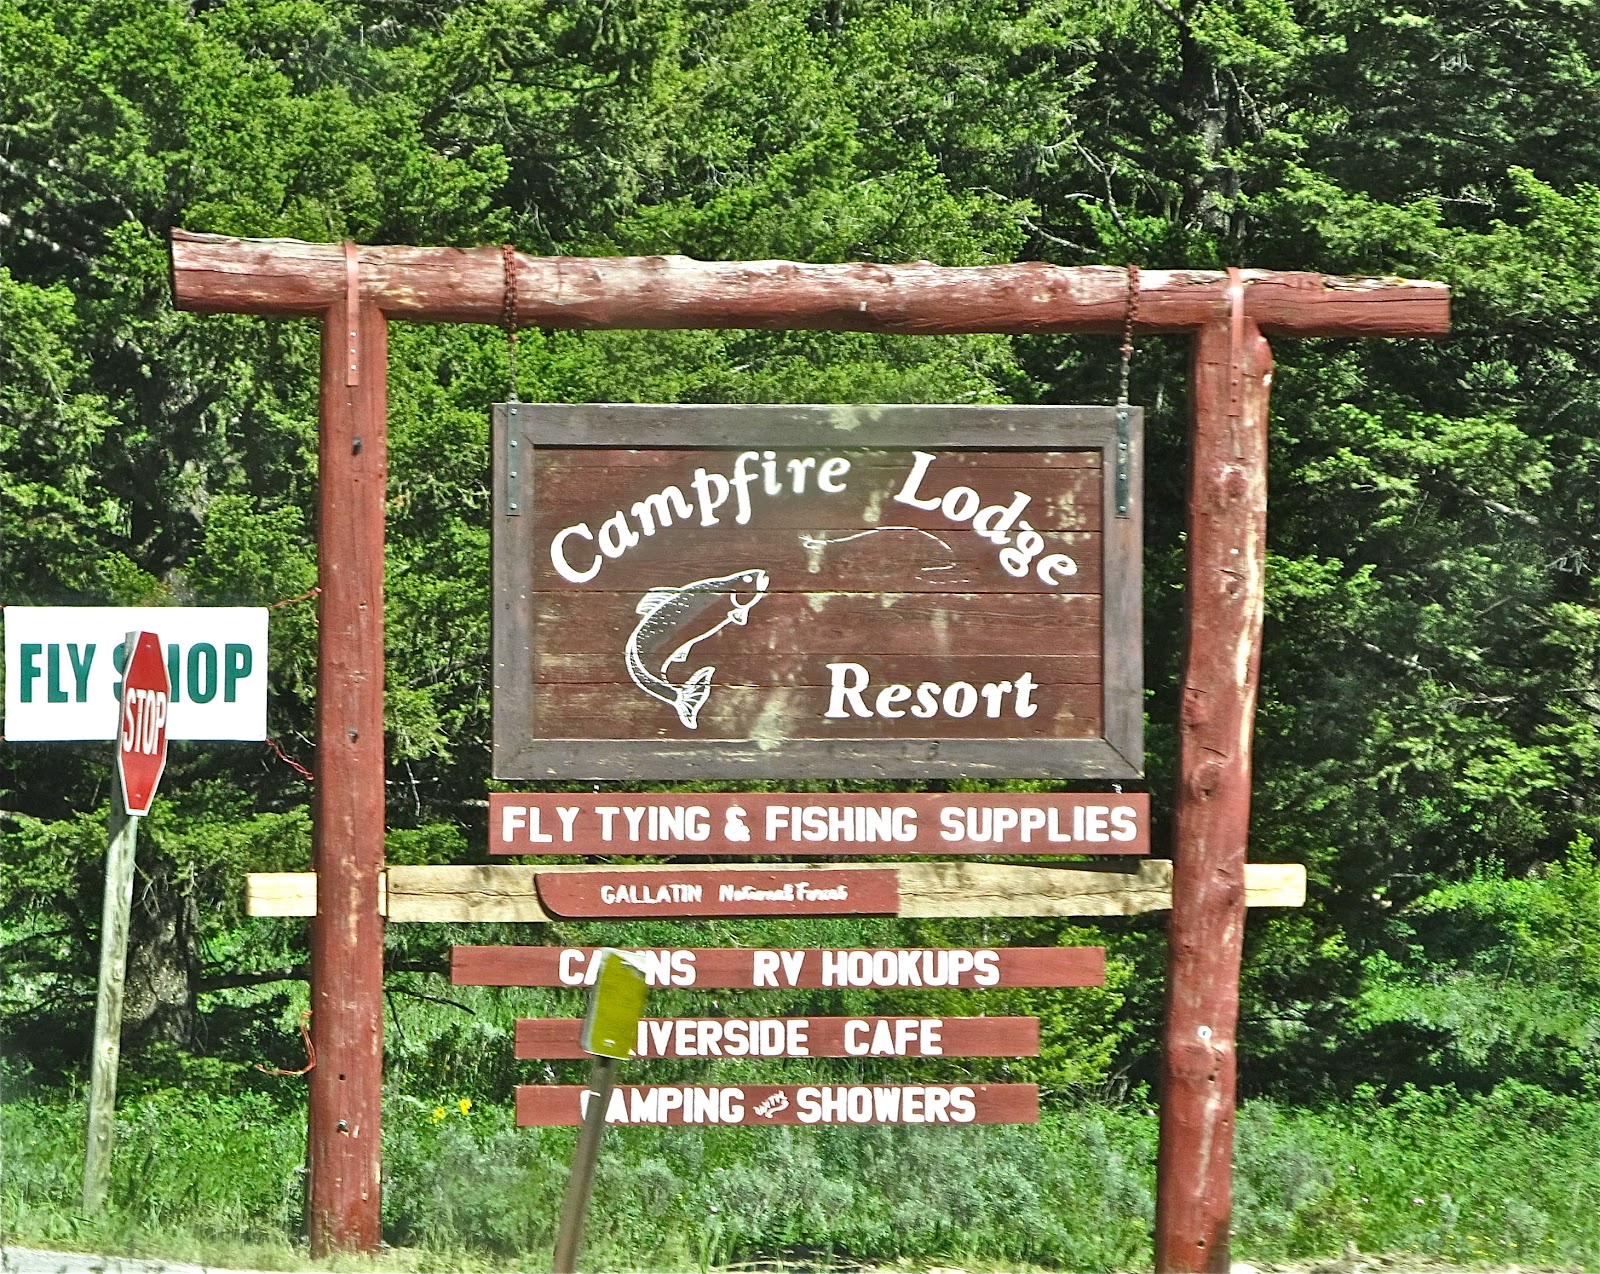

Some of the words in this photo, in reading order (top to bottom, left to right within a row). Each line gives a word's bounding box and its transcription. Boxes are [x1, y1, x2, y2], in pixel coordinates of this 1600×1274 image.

[550, 451, 851, 583] Campfire
[893, 451, 1077, 585] Lodge
[20, 643, 97, 703] FLY
[824, 662, 1038, 718] Resort
[122, 687, 168, 755] STOP
[502, 806, 580, 842] FLY
[595, 805, 711, 842] TYING
[724, 806, 751, 842] &
[765, 805, 918, 843] FISHING
[940, 805, 1137, 842] SUPPLIES
[601, 884, 703, 904] GALLATIN
[753, 950, 805, 987] RV
[822, 950, 1000, 987] HOOKUPS
[627, 1019, 809, 1056] IVERSIDE
[844, 1019, 943, 1055] CAFE
[796, 1086, 976, 1124] SHOWERS
